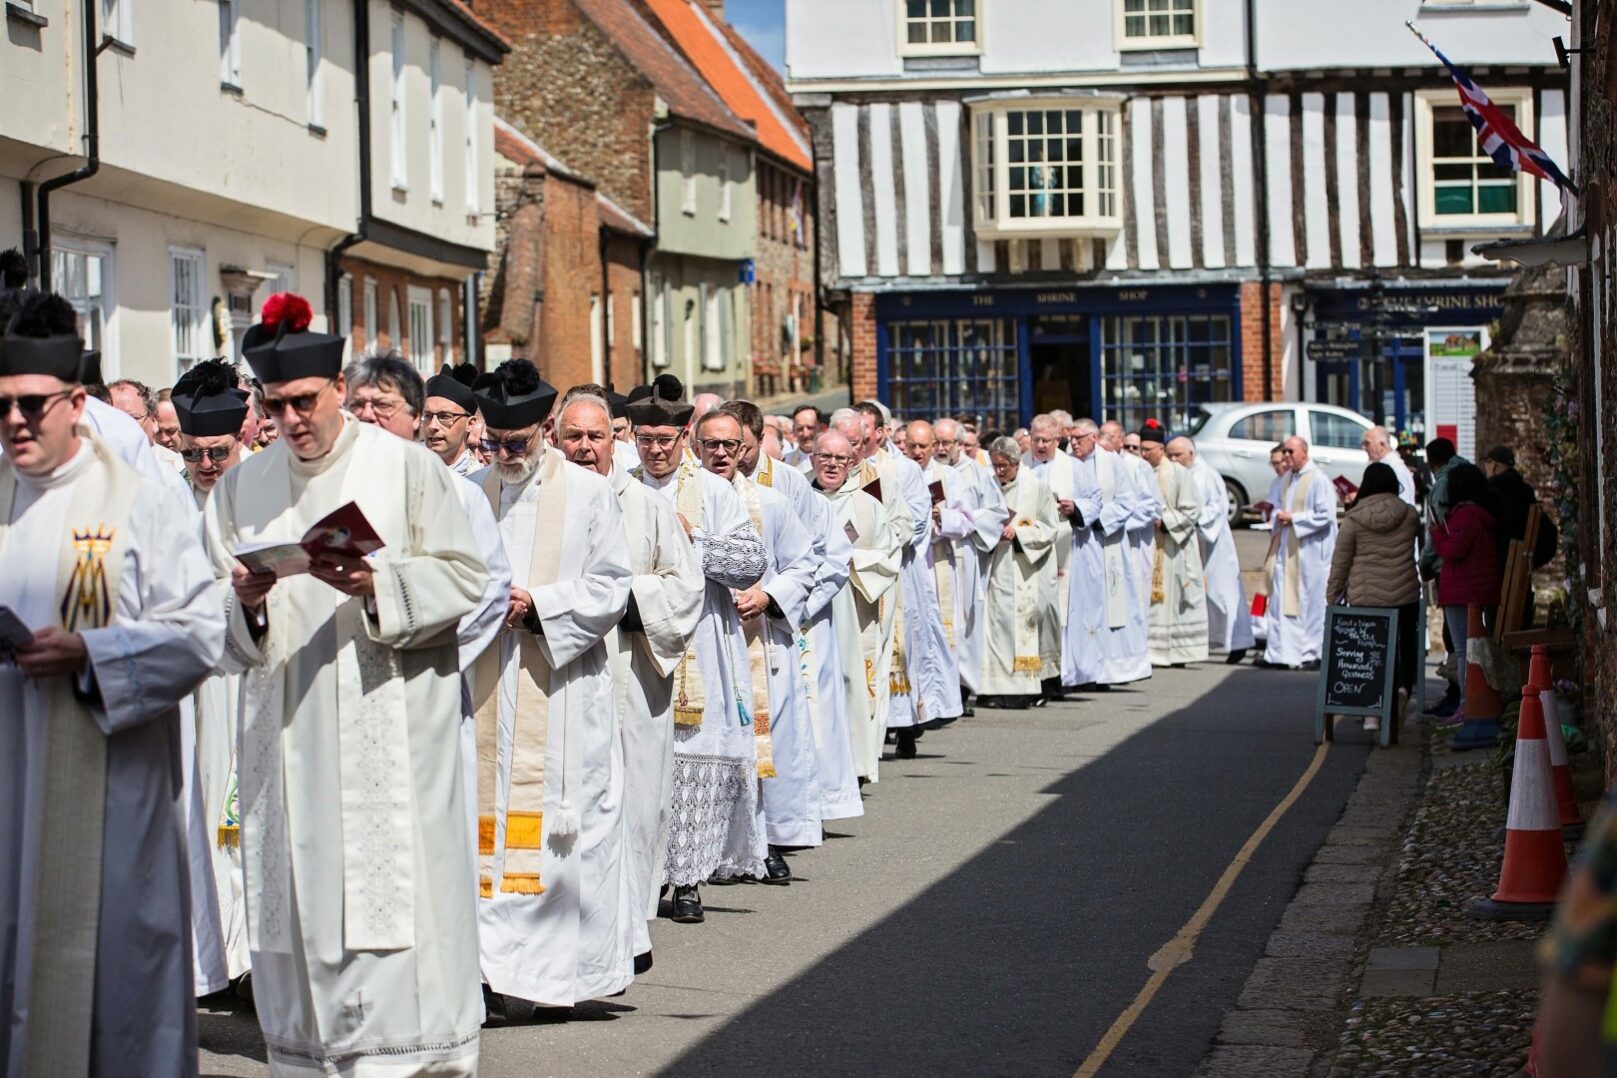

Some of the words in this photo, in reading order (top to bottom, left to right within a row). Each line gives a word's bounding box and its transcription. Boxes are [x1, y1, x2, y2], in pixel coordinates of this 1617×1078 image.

[972, 294, 994, 306] THE
[1036, 292, 1078, 304] SHRINE
[1118, 290, 1148, 301] SHOP
[1473, 294, 1506, 308] SHO
[1336, 647, 1364, 663] Serving
[1333, 681, 1366, 694] OPEN
